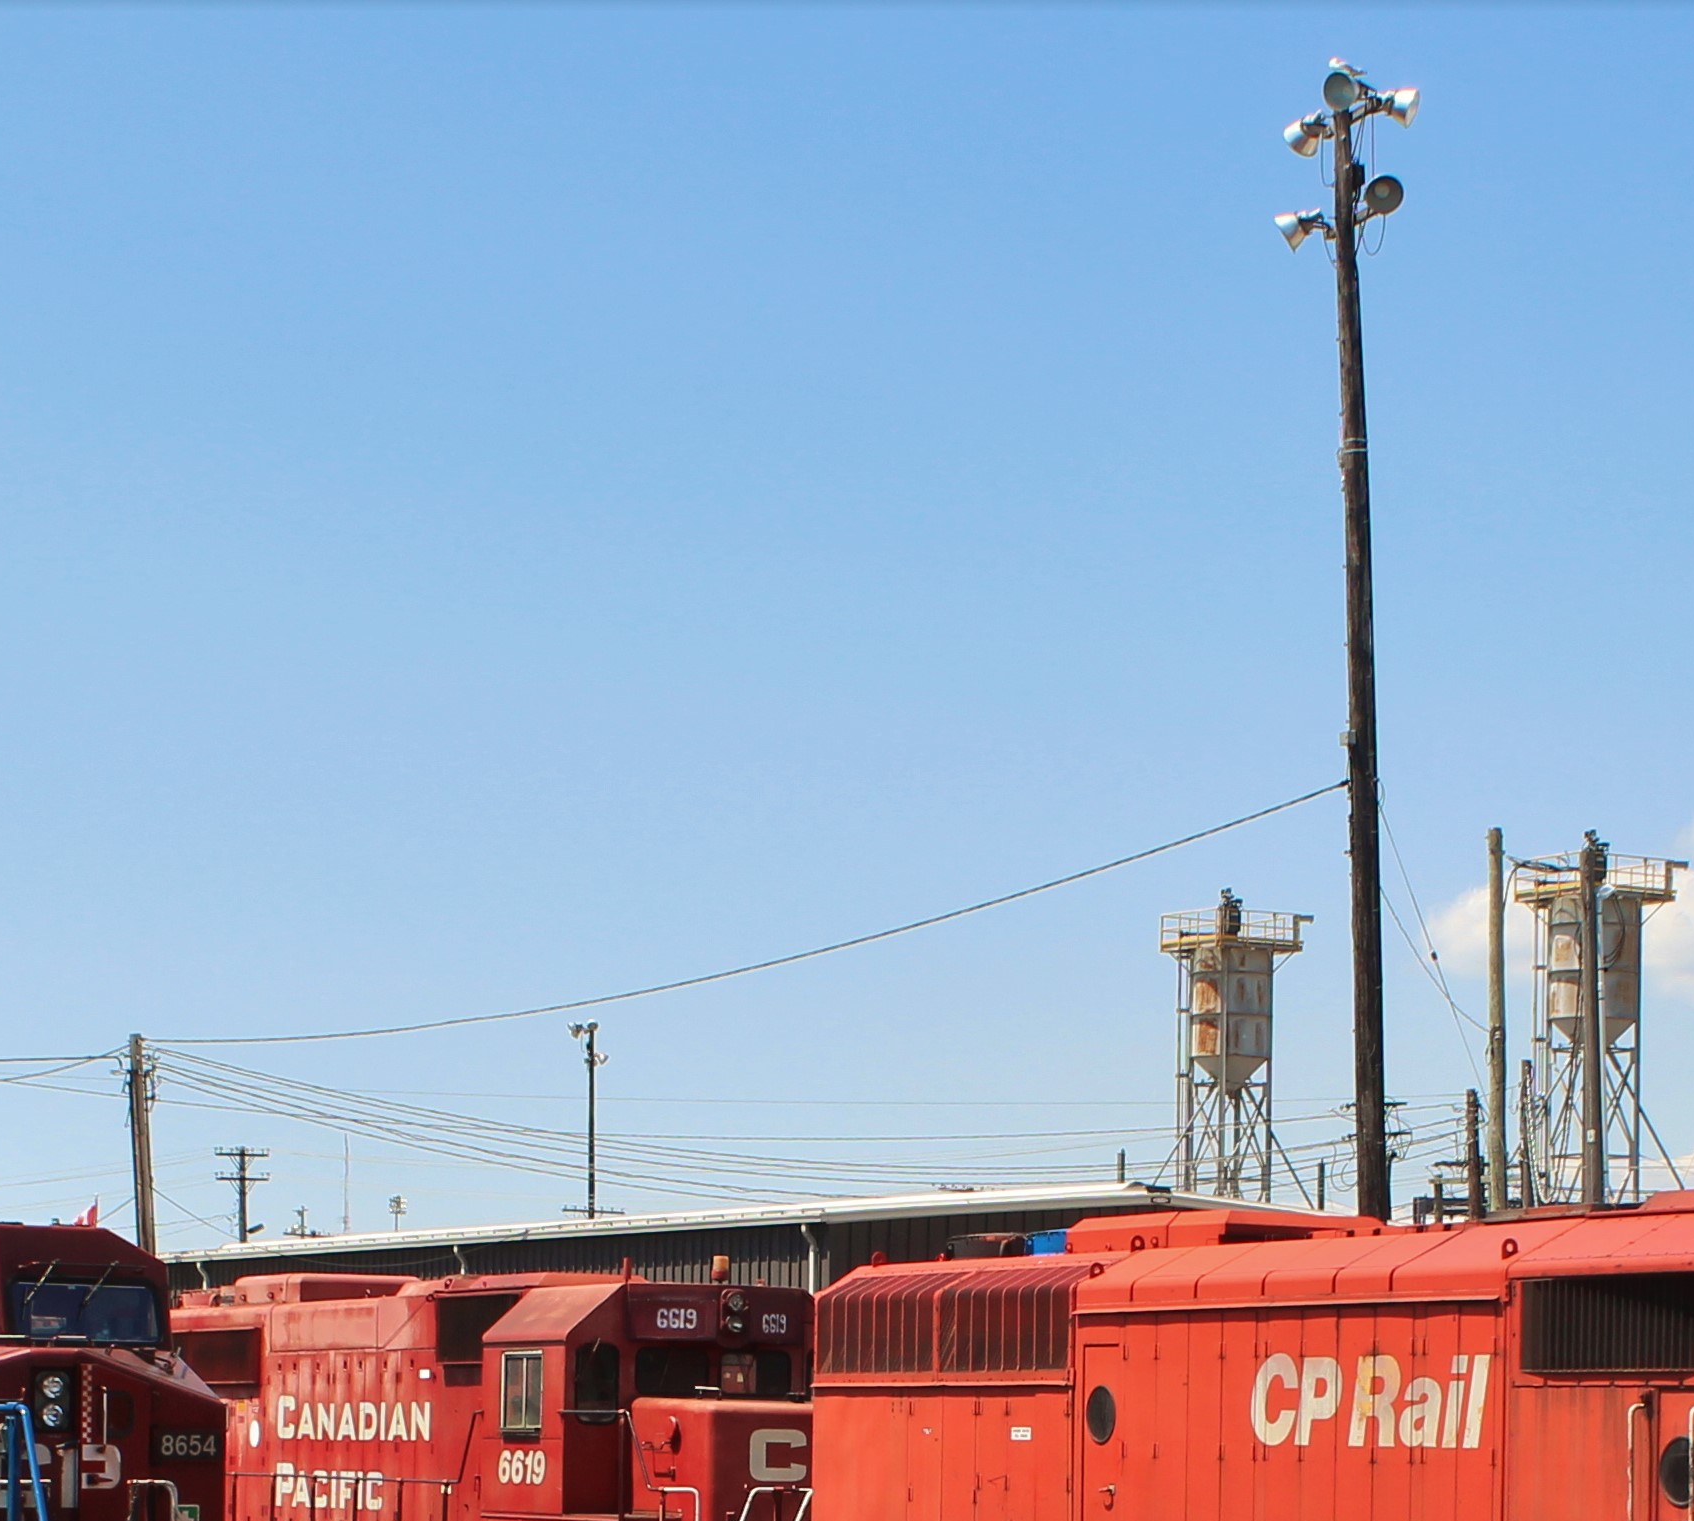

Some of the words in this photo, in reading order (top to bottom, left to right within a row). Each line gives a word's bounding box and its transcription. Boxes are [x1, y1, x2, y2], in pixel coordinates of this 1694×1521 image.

[657, 1308, 697, 1330] 6619
[762, 1313, 787, 1334] 6619
[276, 1395, 431, 1441] CANADIAN
[1250, 1352, 1343, 1447] CP
[1347, 1354, 1491, 1449] Rail
[161, 1434, 216, 1456] 8654
[749, 1428, 807, 1482] C
[274, 1462, 384, 1511] PACIFIC
[498, 1449, 546, 1485] 6619
